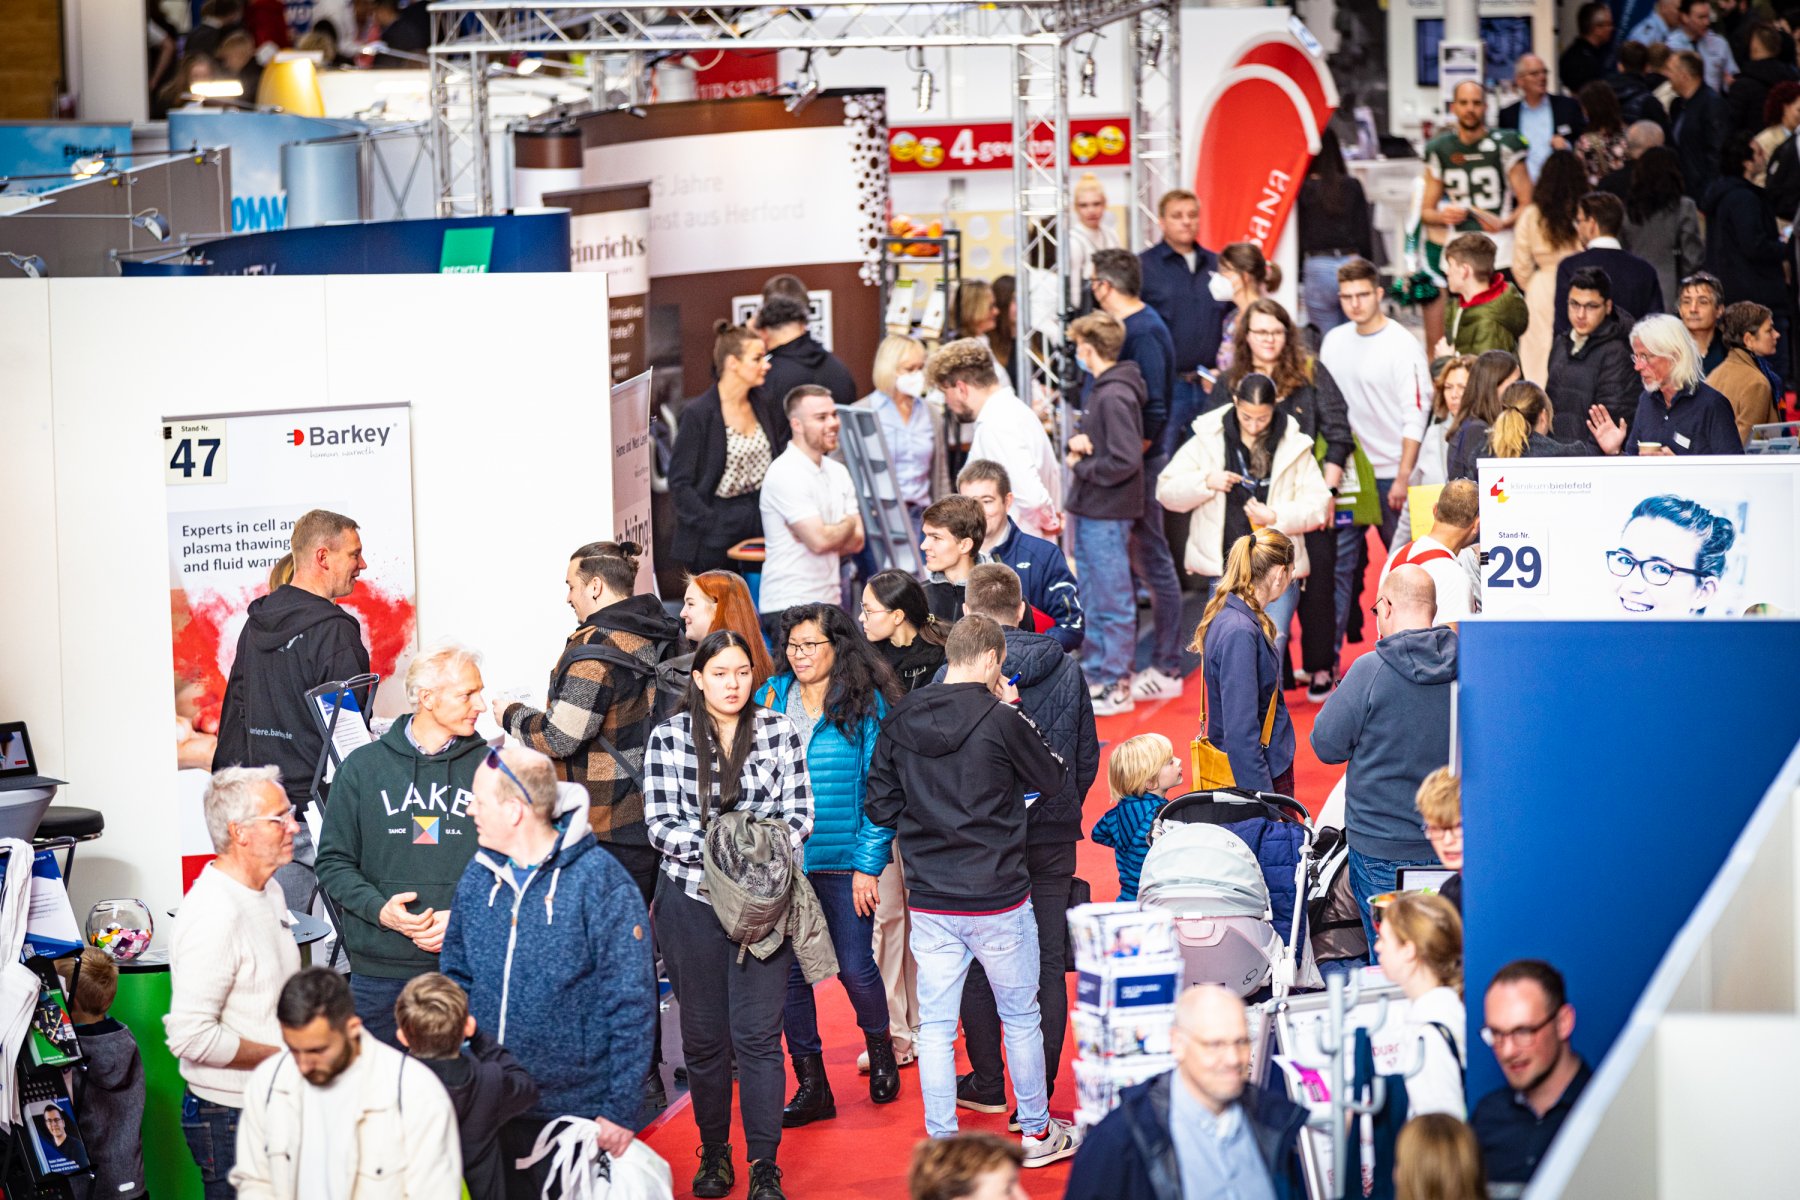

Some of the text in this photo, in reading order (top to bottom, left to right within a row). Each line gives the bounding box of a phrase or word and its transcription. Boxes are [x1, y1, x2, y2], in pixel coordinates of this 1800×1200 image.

[949, 128, 978, 165] 4
[670, 172, 725, 196] Jahre
[1443, 167, 1501, 210] 23
[685, 208, 721, 229] aus
[725, 196, 805, 225] Herford
[309, 424, 391, 447] Barkey
[169, 438, 221, 478] 47
[182, 519, 296, 539] Experts in cell an
[1498, 531, 1530, 539] Stand-Nr.
[183, 537, 291, 557] plasma thawing
[183, 559, 209, 573] and
[213, 557, 244, 571] fluid
[1487, 545, 1542, 589] 29
[380, 782, 473, 818] LAKE
